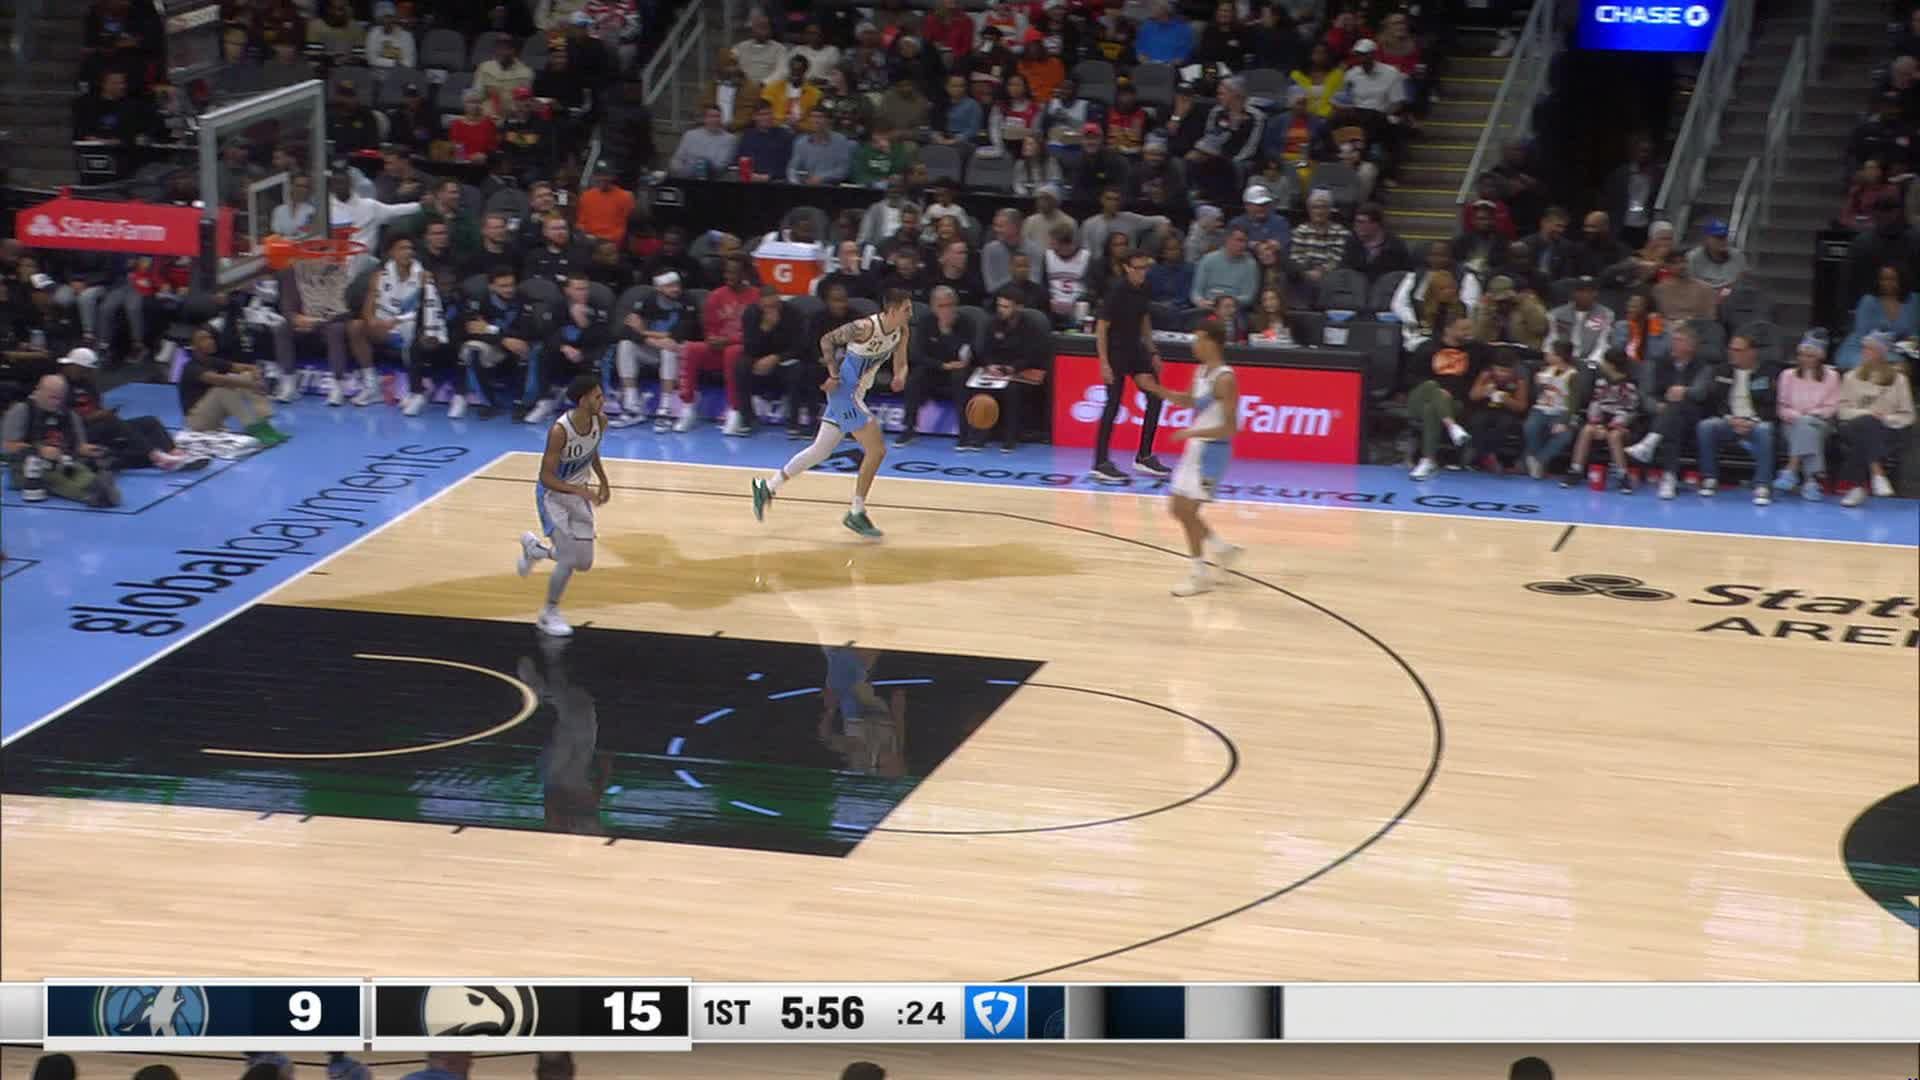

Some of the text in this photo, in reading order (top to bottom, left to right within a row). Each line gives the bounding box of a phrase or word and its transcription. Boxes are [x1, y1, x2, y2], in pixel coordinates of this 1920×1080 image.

[1595, 5, 1683, 24] CHASE
[773, 263, 793, 283] G
[567, 444, 583, 458] 10
[892, 460, 1131, 487] Georg
[1413, 494, 1542, 514] Gas
[1688, 584, 1919, 618] Stat
